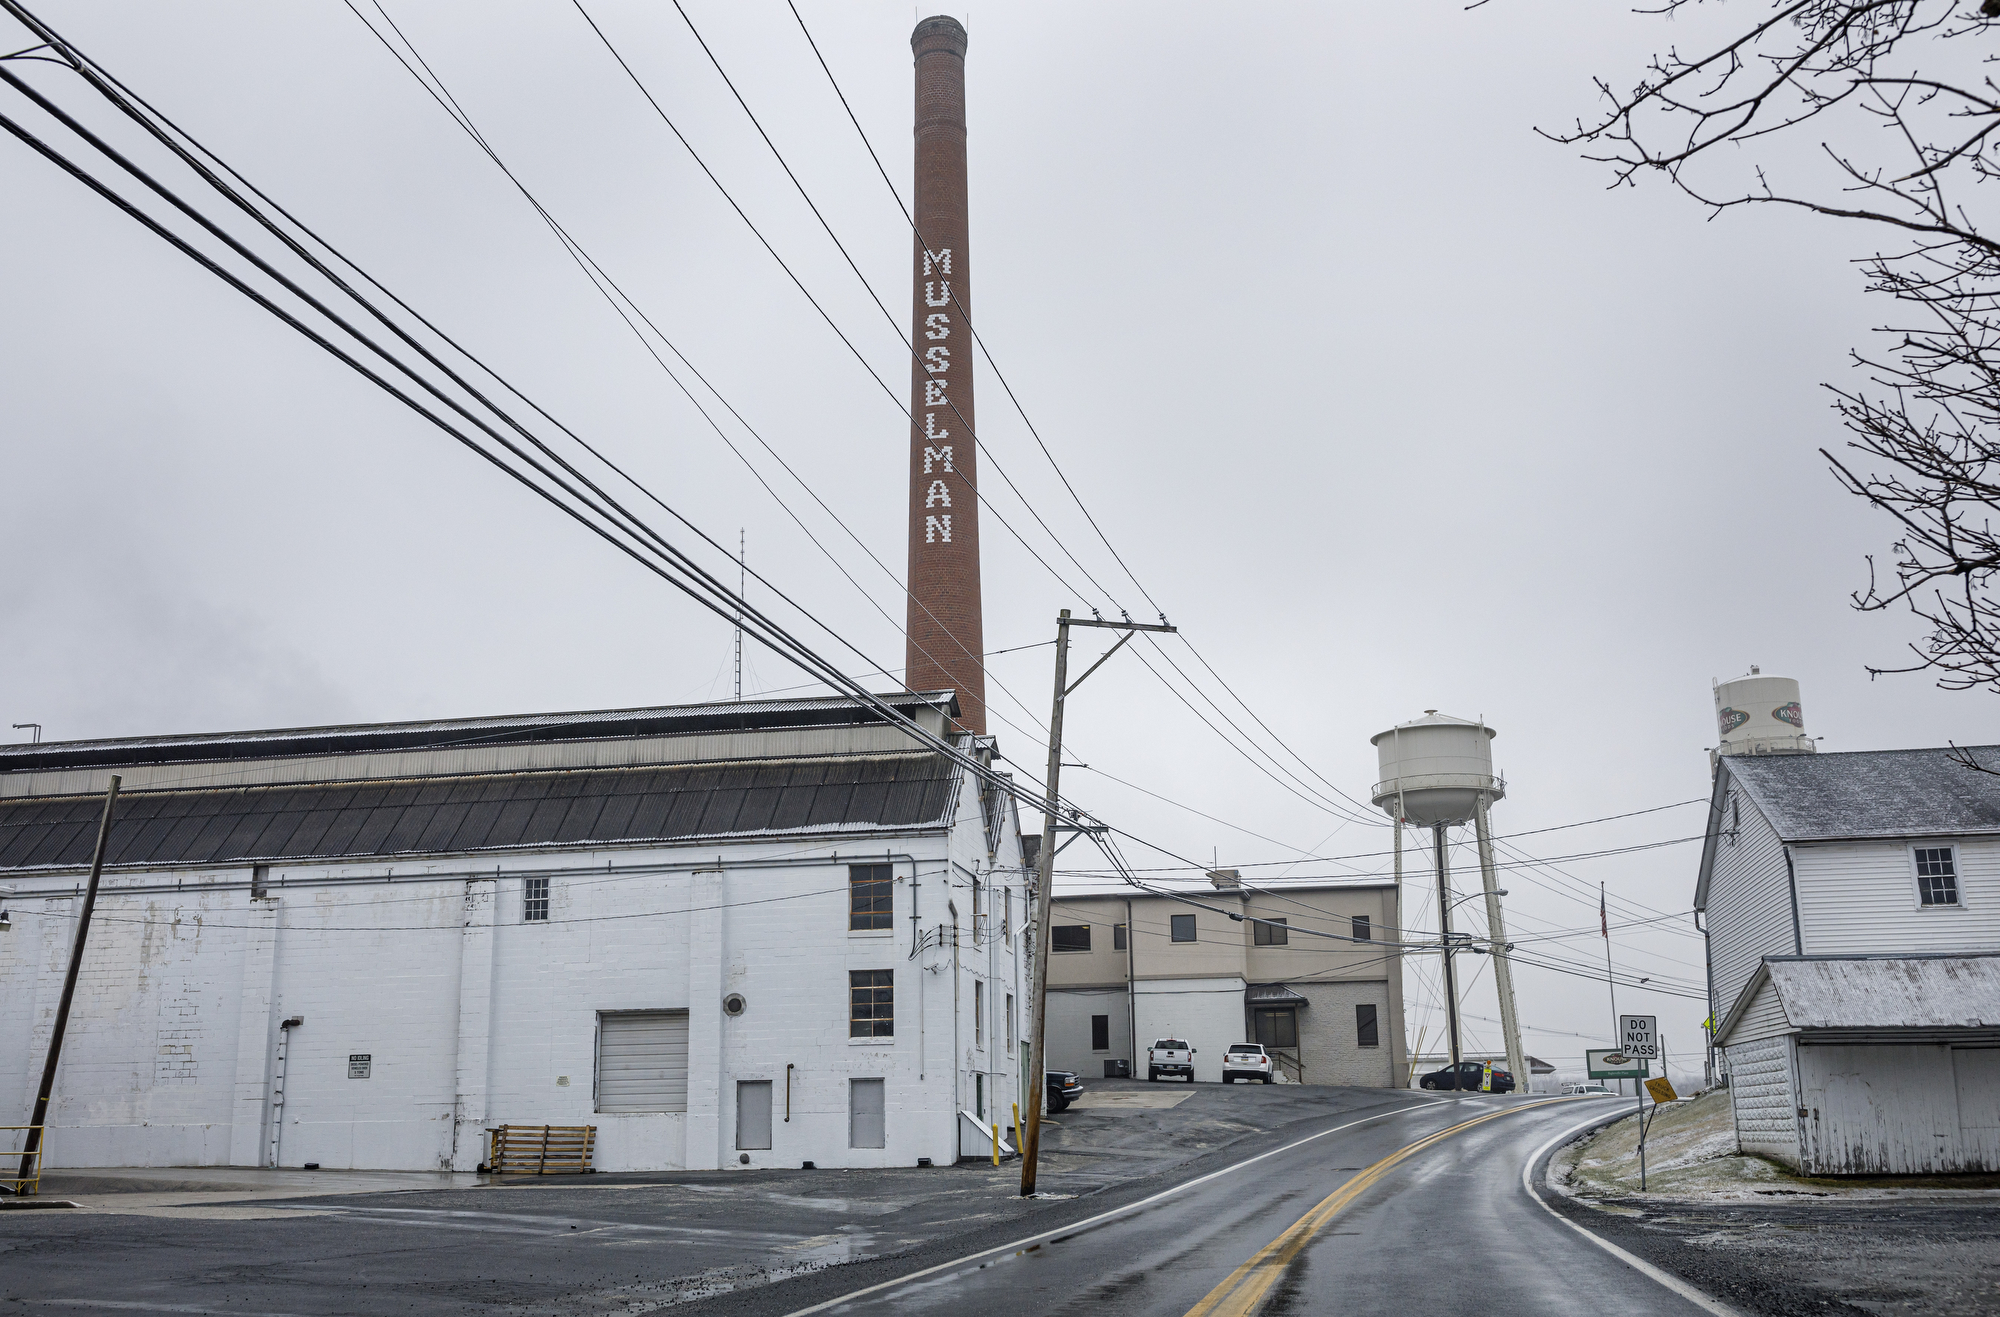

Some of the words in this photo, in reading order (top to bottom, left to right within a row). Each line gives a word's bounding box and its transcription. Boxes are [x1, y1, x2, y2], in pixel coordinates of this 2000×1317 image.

[923, 248, 953, 543] MUSSELMAN
[1630, 1020, 1646, 1030] DO
[1627, 1032, 1650, 1042] NOT
[1624, 1044, 1654, 1055] PASS
